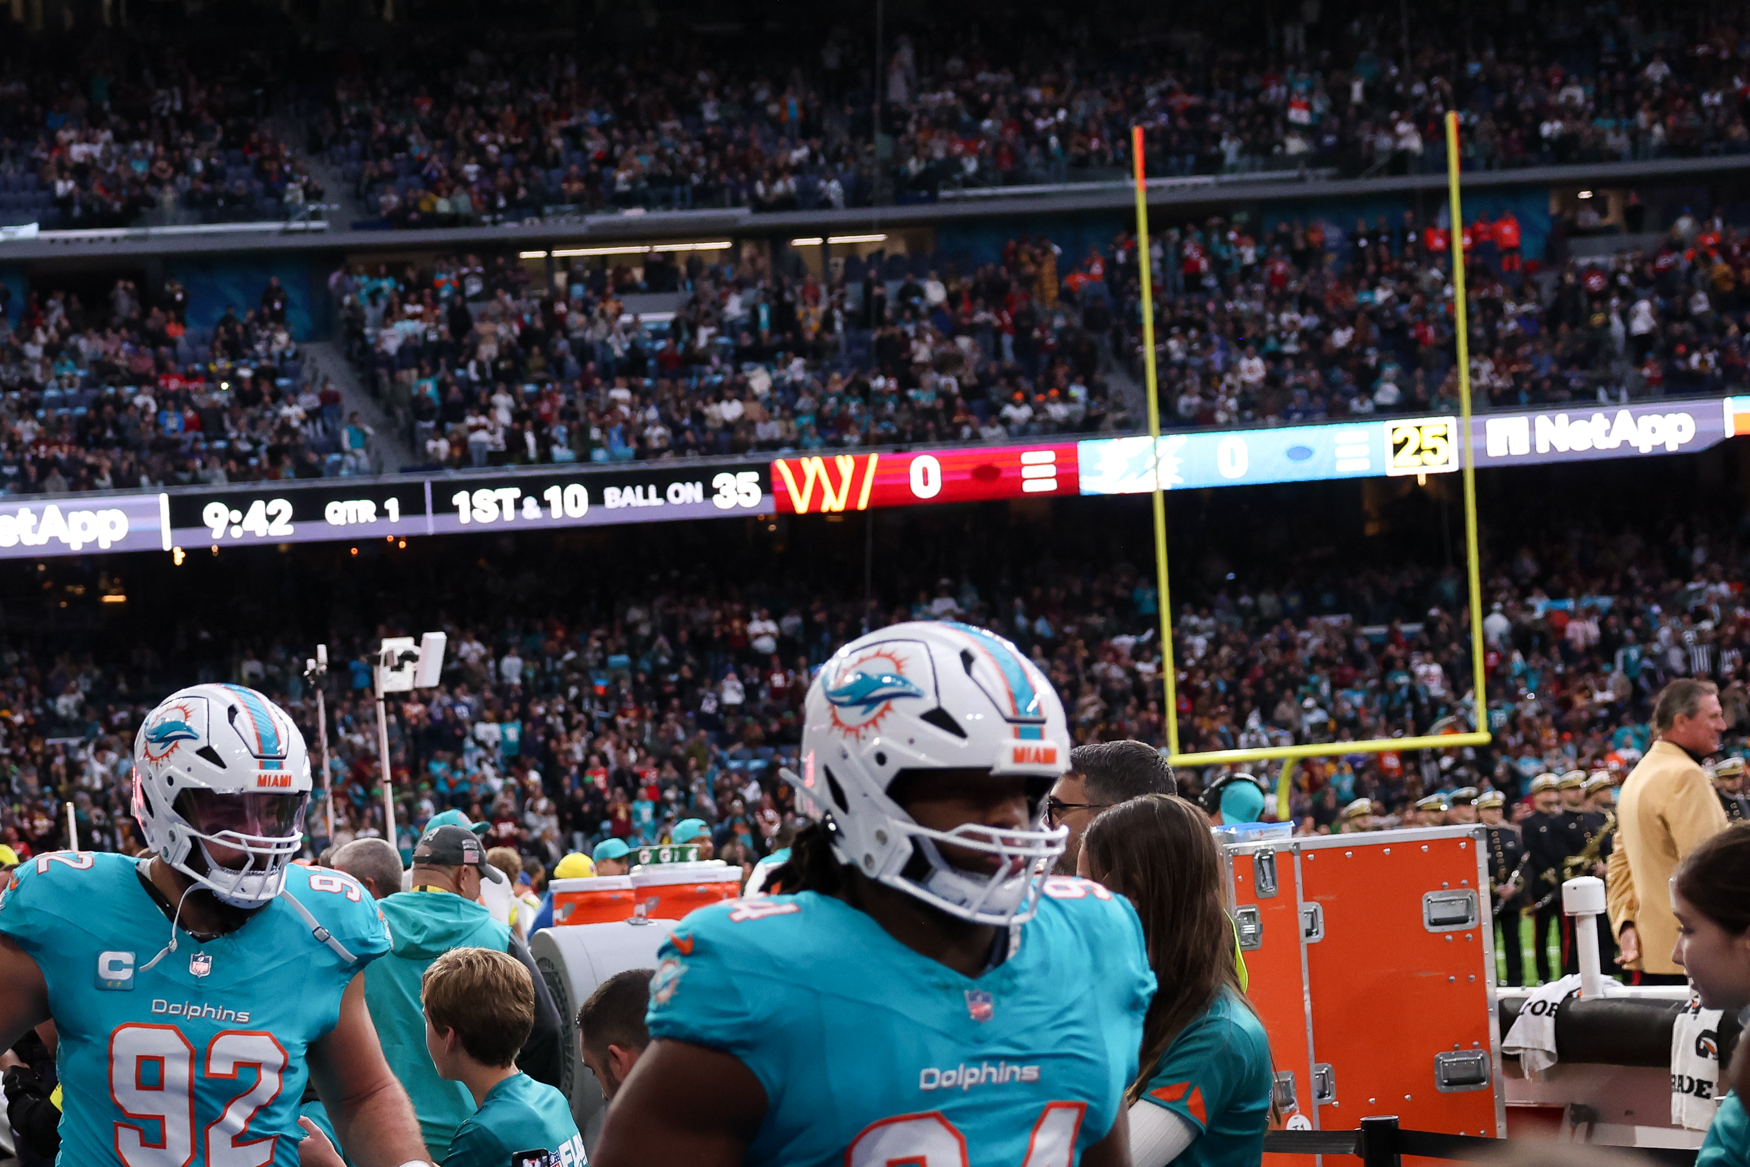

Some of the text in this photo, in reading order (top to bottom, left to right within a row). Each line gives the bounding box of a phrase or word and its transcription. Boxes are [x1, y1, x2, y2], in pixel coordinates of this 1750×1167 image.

[1392, 425, 1450, 468] 25
[1534, 409, 1696, 454] NetApp
[909, 455, 942, 498] 0
[1217, 436, 1249, 479] 0
[452, 483, 589, 525] 1ST & 10
[603, 471, 762, 509] BALL ON 35
[202, 497, 400, 540] 9:42 QTR 1
[256, 774, 293, 788] MIAMI
[98, 951, 135, 981] C
[151, 999, 251, 1024] Dolphins
[918, 1061, 1041, 1092] Dolphins
